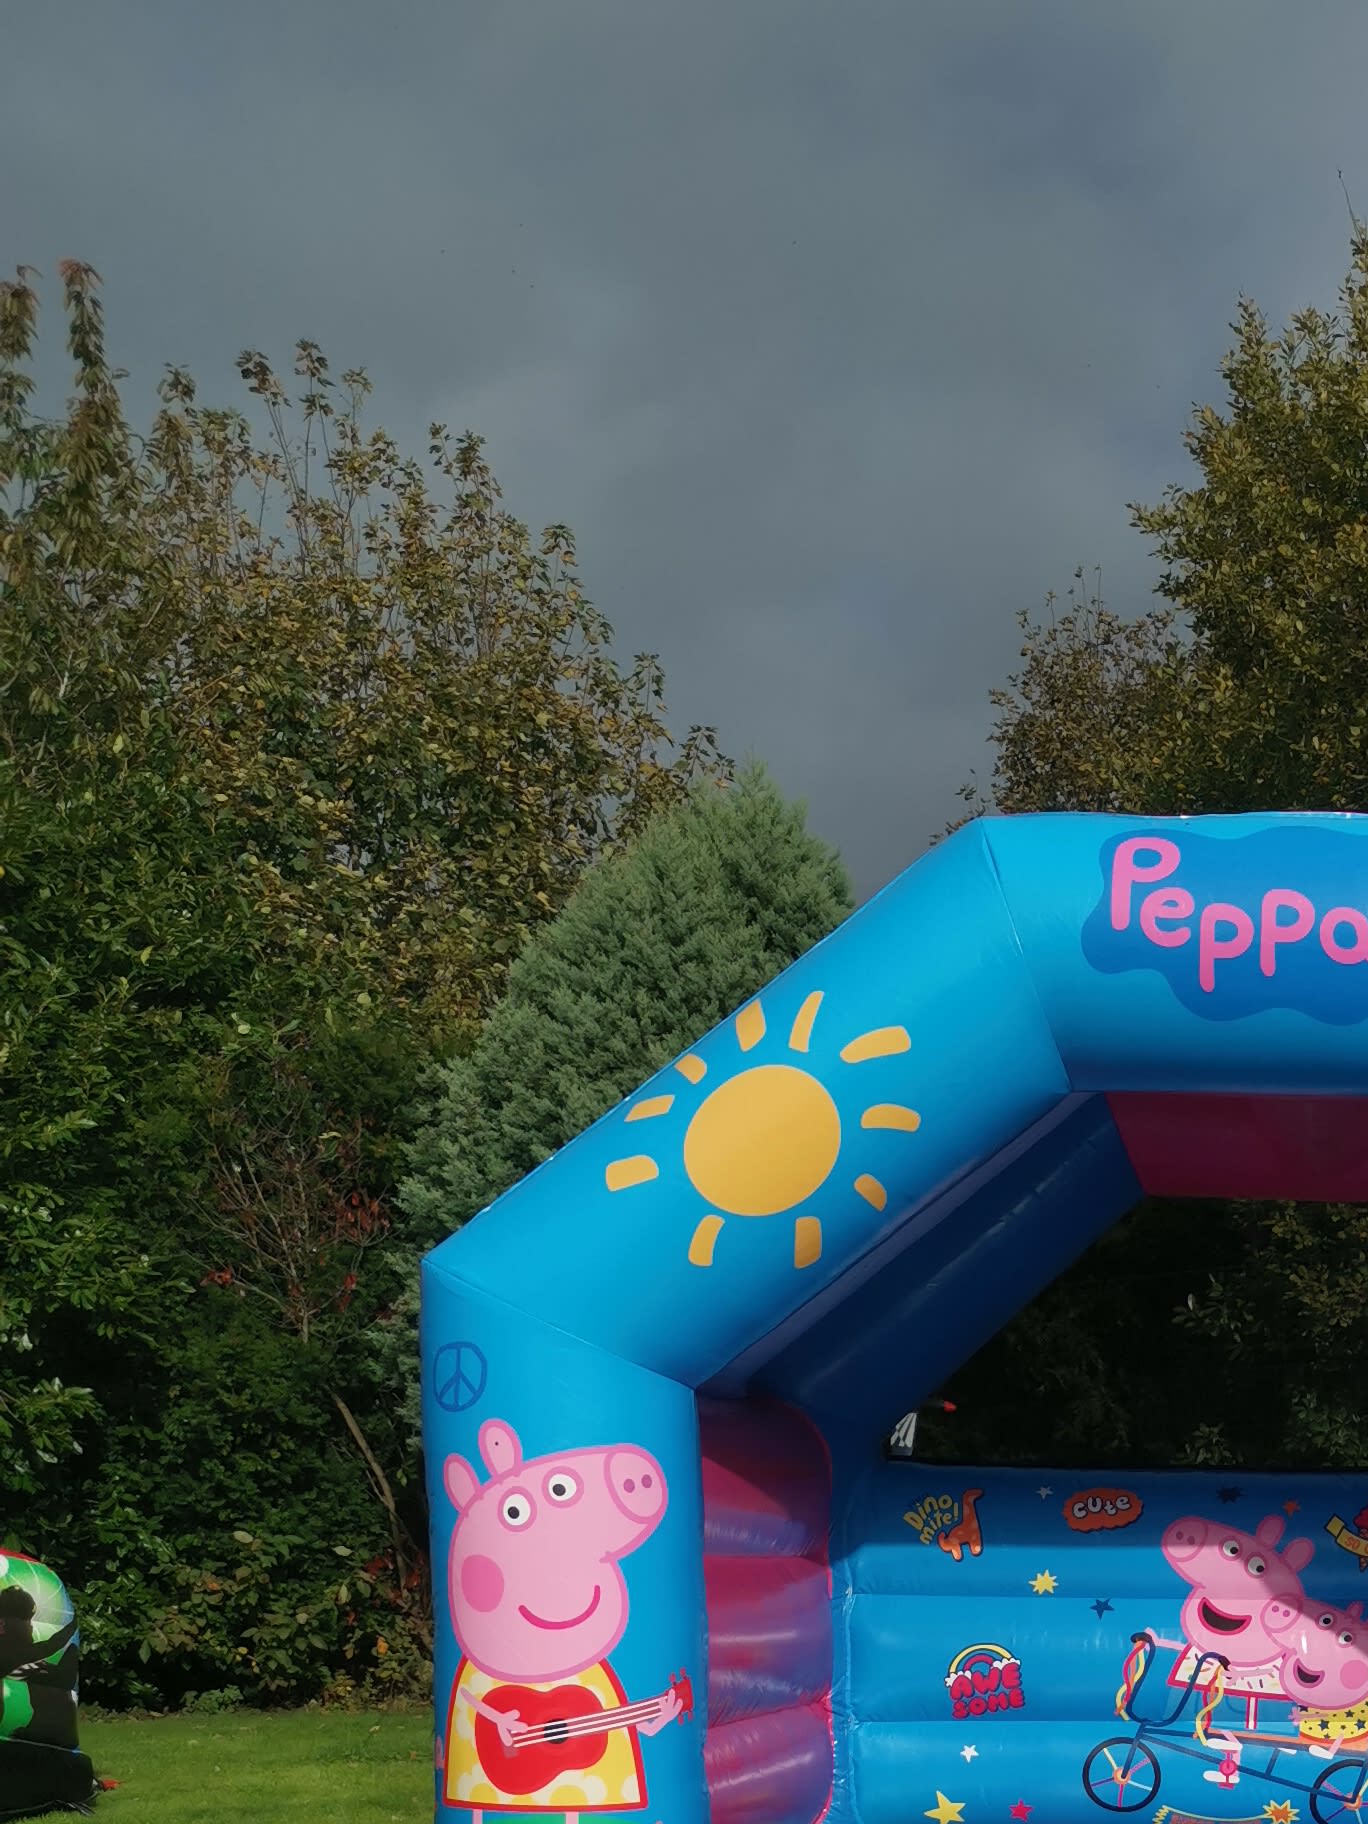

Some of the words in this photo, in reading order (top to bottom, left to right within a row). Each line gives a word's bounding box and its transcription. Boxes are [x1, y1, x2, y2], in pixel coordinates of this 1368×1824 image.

[903, 1494, 953, 1530] Dino
[1344, 1537, 1361, 1550] SO
[950, 1662, 1021, 1701] AWE
[952, 1688, 1025, 1719] SOME
